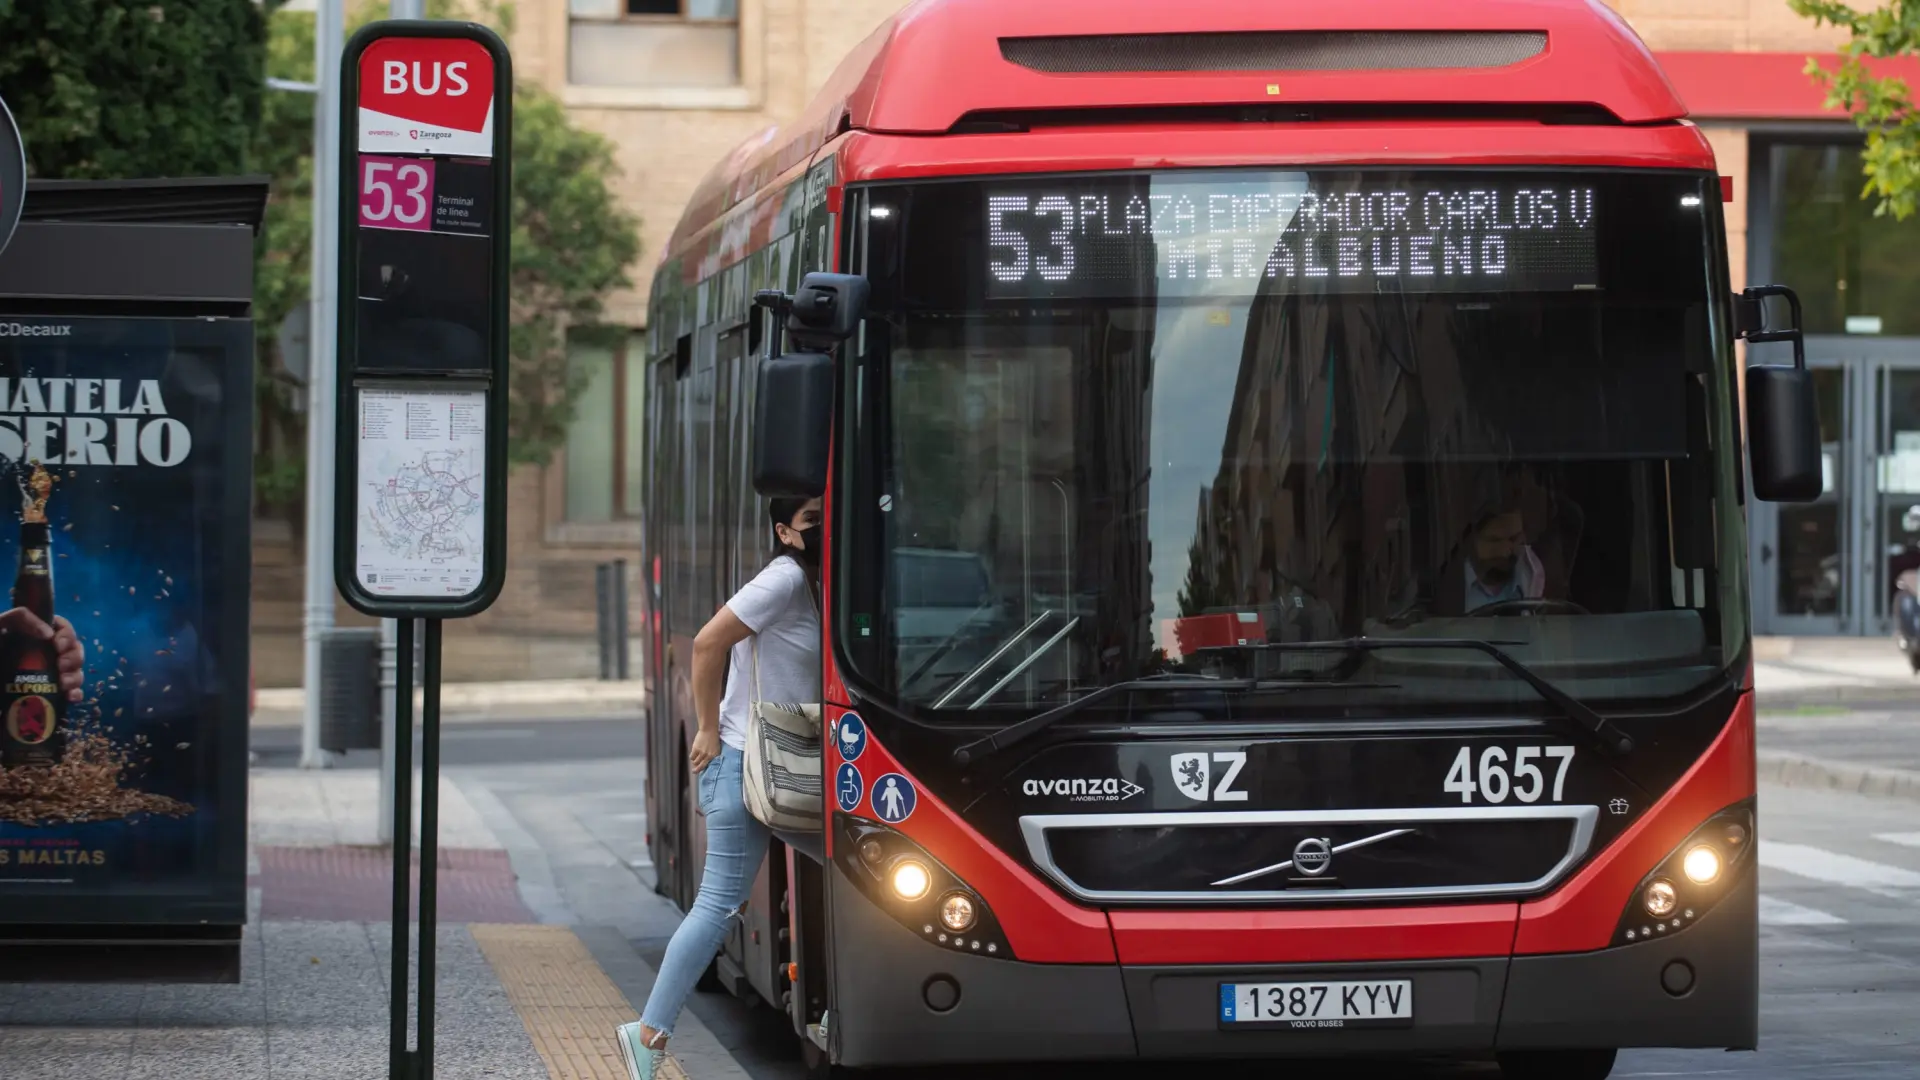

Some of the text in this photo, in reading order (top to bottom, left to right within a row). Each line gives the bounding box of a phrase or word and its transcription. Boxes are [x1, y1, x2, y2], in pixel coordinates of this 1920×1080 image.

[383, 60, 469, 97] BUS
[420, 130, 452, 140] Zaragoza
[361, 161, 428, 224] 53
[438, 195, 474, 206] Terminal
[436, 206, 448, 215] de
[1080, 189, 1592, 235] PLAZA EMPERADOR CARLOS V
[989, 196, 1075, 281] 53
[1168, 234, 1505, 278] MIRALBUENO
[14, 674, 49, 684] AMBAR
[1443, 745, 1576, 804] 4657
[1022, 778, 1119, 796] avanza
[18, 849, 105, 865] MALTAS
[1249, 984, 1403, 1018] 1387 KYV
[1224, 1007, 1232, 1016] E
[1290, 1019, 1344, 1028] VOLVO BUSES
